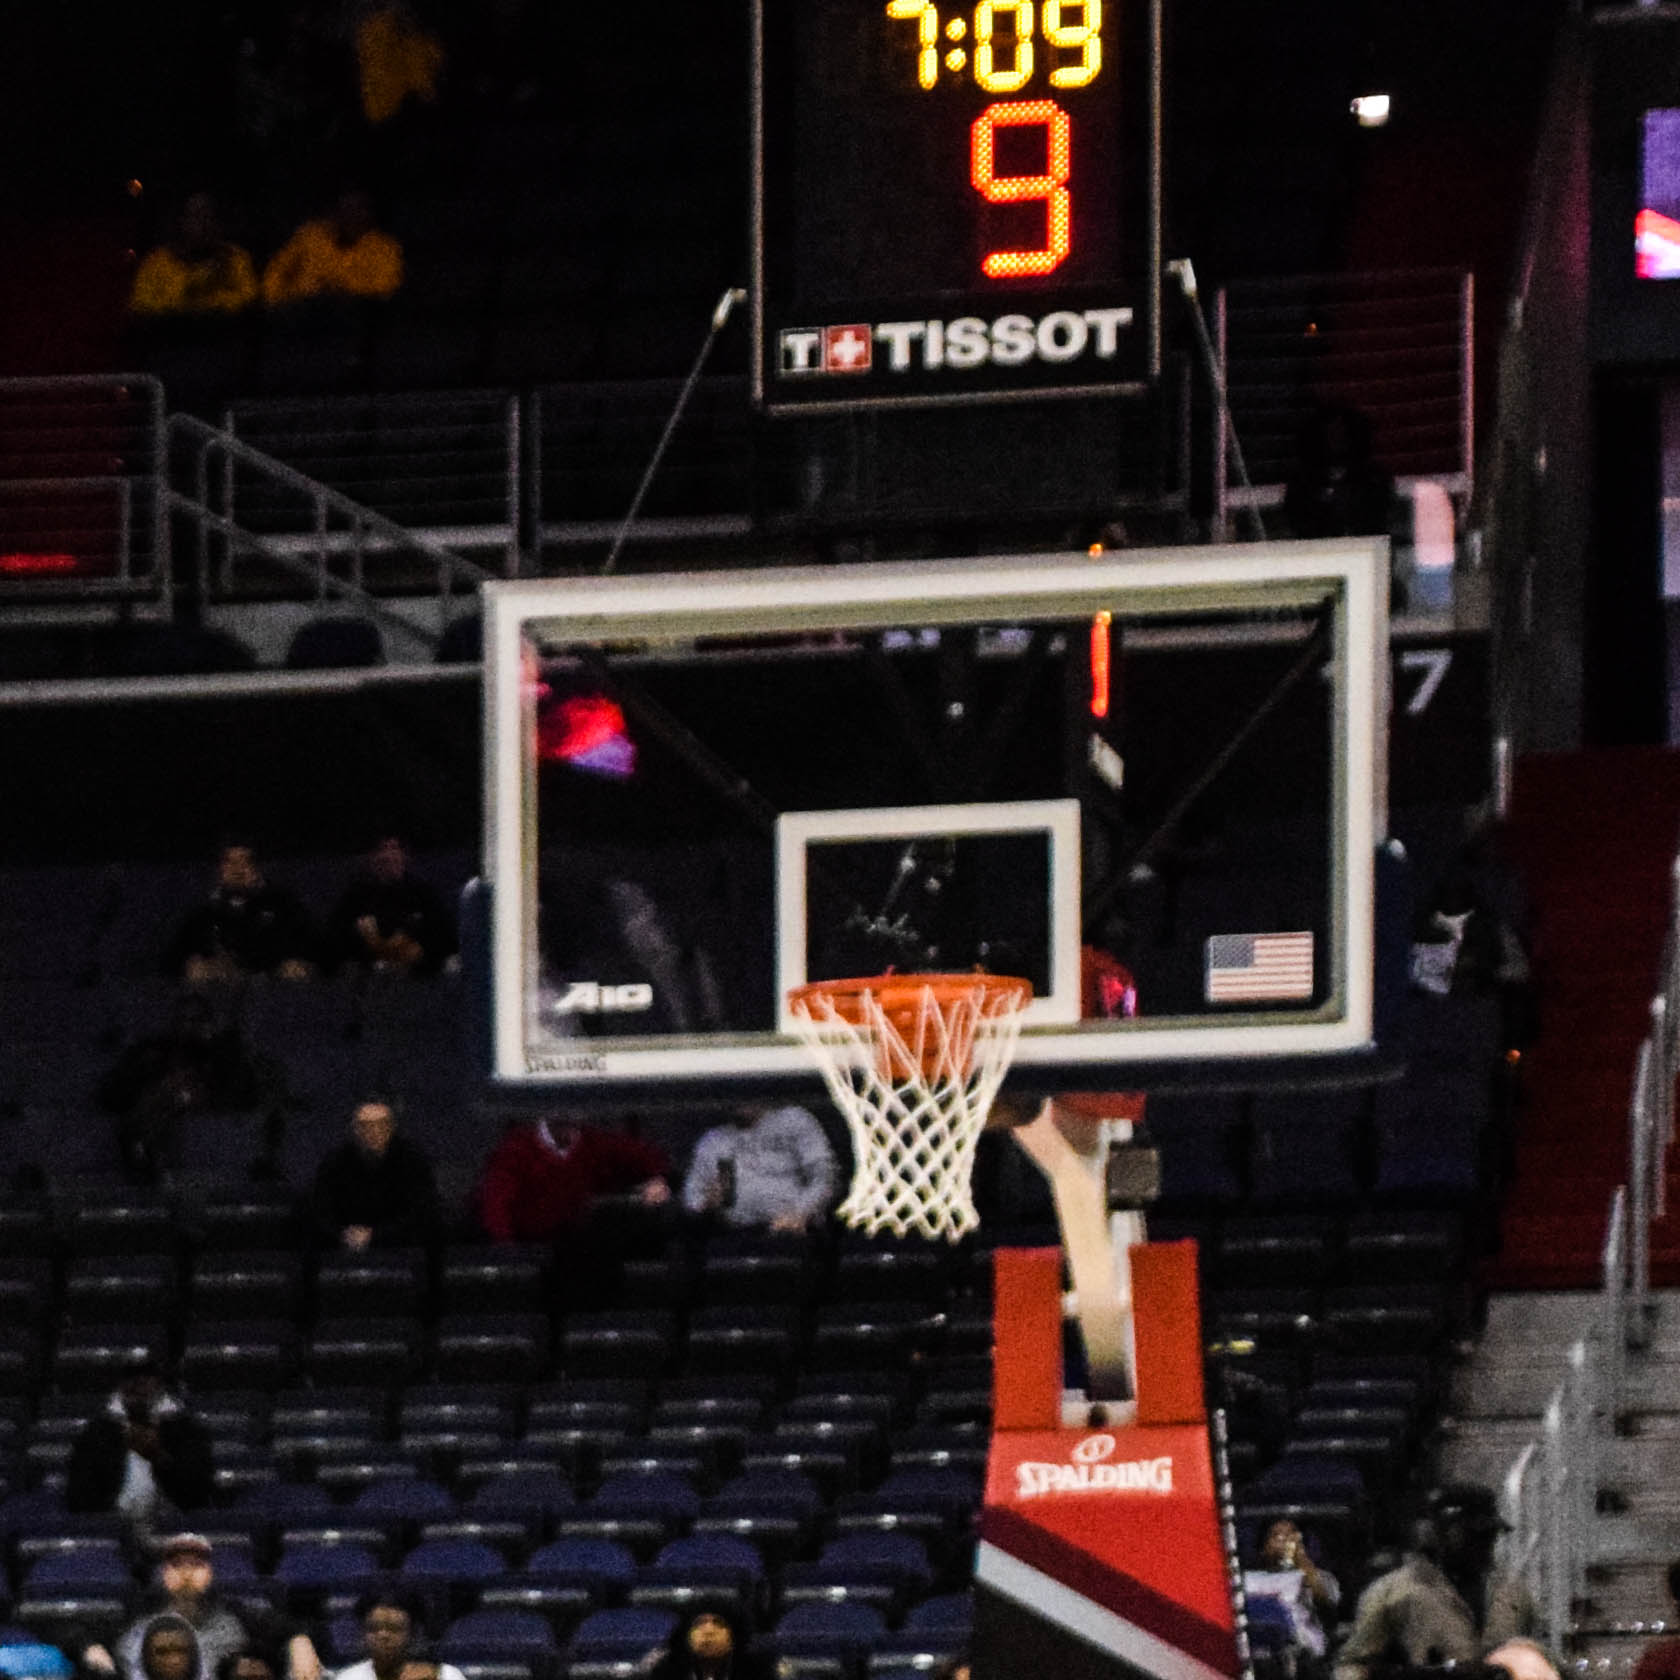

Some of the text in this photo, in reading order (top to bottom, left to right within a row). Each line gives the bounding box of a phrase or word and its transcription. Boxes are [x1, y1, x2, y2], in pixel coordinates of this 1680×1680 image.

[886, 0, 1103, 92] 7:09
[970, 100, 1070, 278] 9
[875, 307, 1134, 371] TISSOT
[1015, 1456, 1174, 1499] SPALDING
